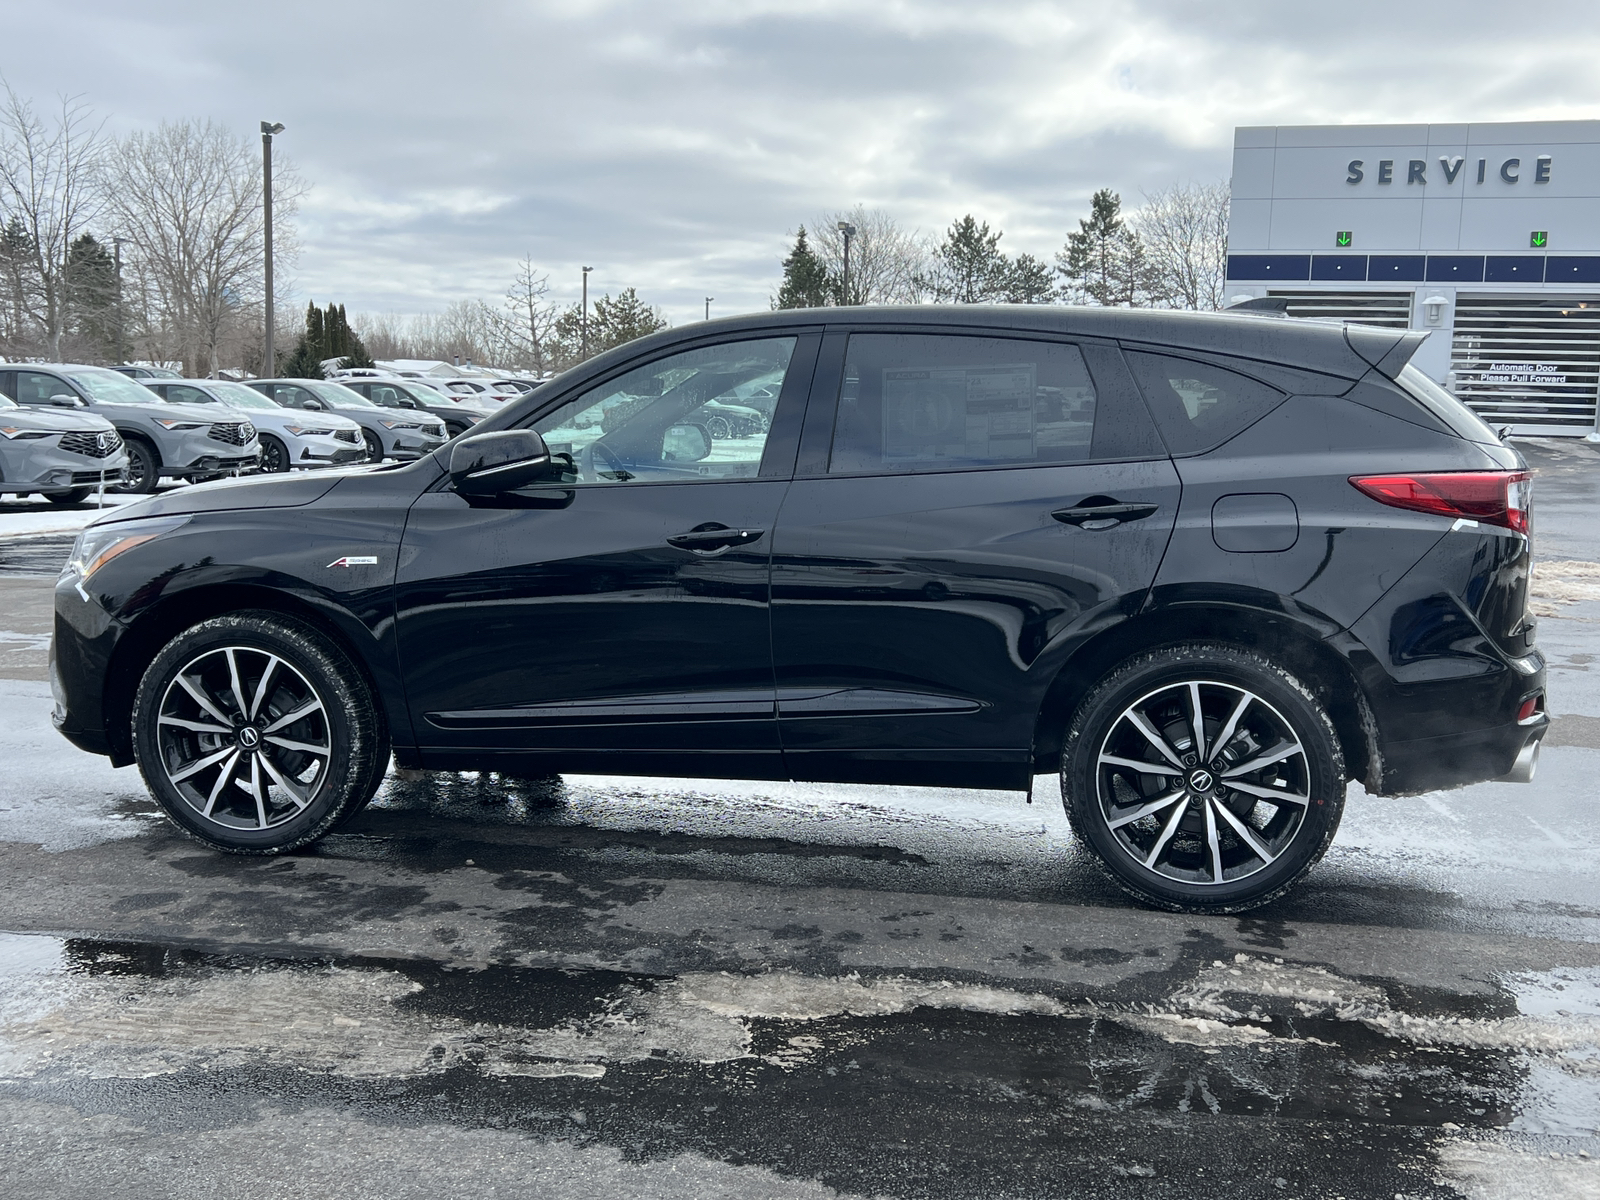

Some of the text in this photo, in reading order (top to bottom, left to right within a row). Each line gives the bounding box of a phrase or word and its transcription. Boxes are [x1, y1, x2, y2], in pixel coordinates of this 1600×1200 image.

[1346, 155, 1552, 185] SERVICE
[1489, 363, 1558, 373] Automatic Door
[895, 372, 927, 380] ACURA
[1480, 374, 1565, 384] Please Pull Forward
